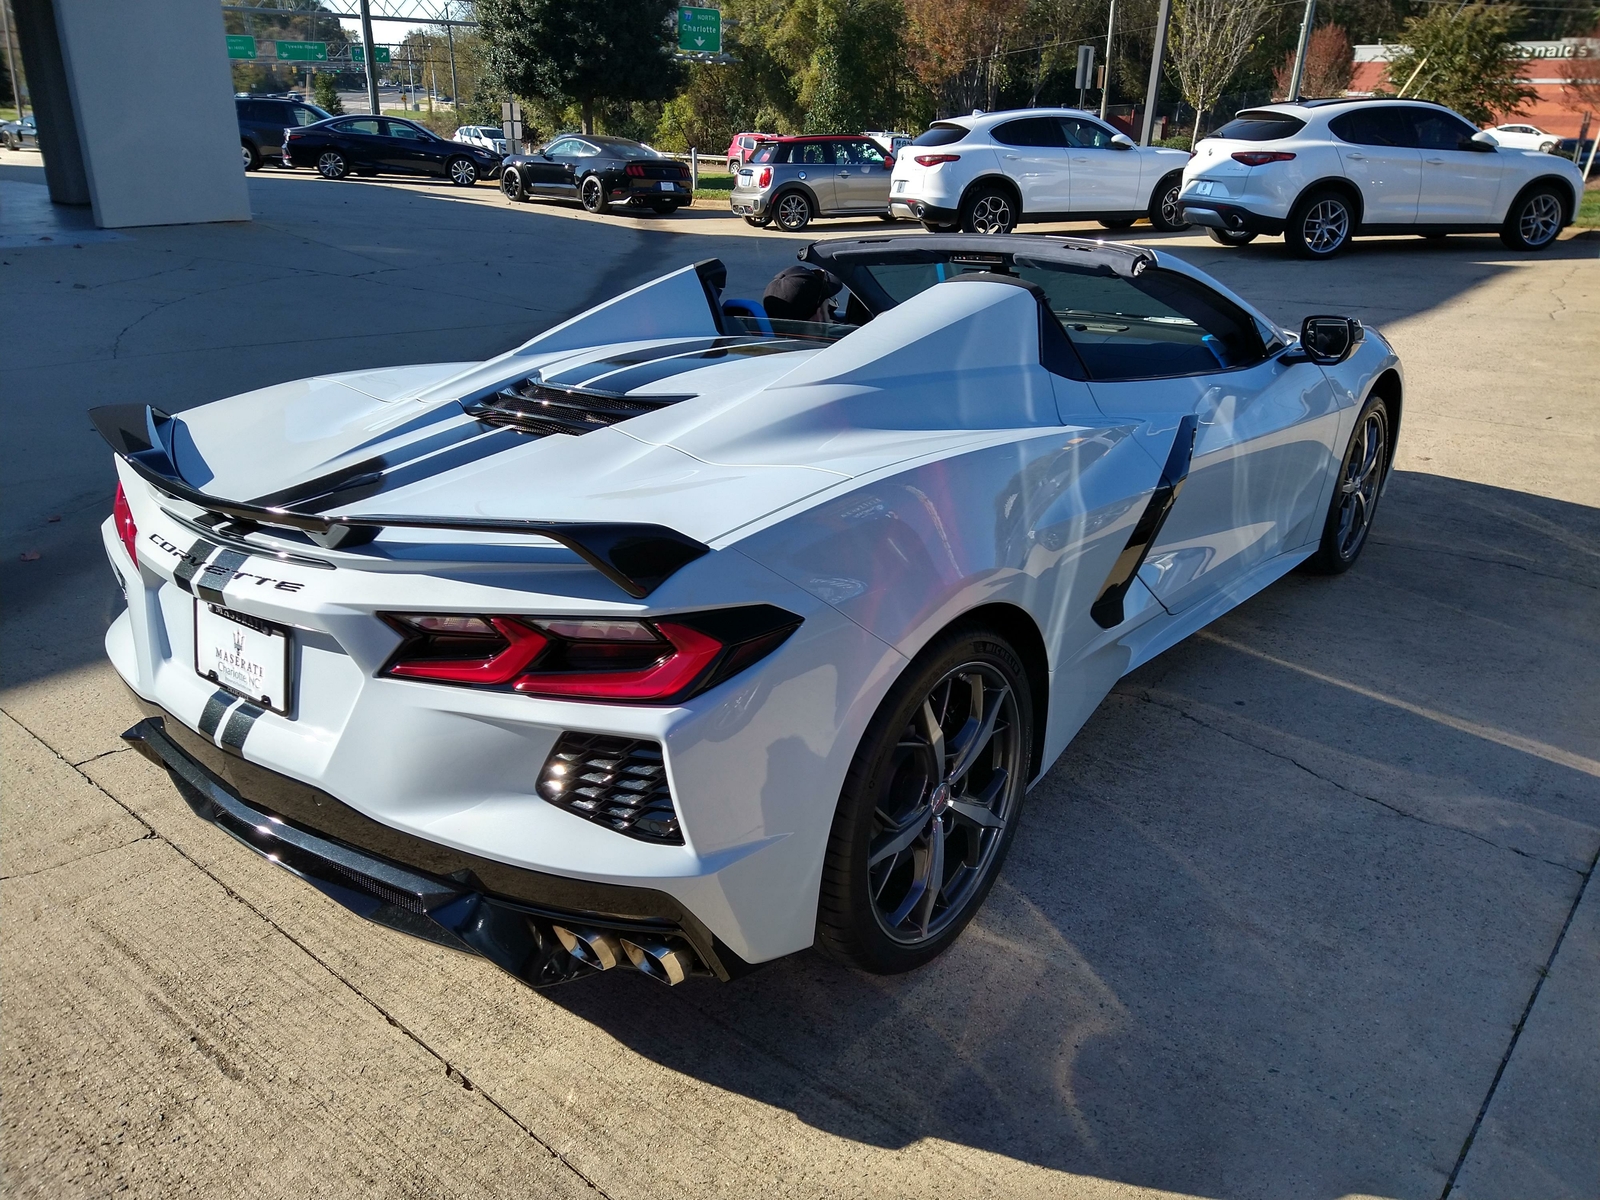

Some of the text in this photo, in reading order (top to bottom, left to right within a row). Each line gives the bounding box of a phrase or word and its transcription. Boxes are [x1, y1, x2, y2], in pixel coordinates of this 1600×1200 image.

[682, 24, 716, 33] Charlotte
[148, 533, 305, 593] CORVETTE
[215, 646, 264, 678] MASERATI
[985, 642, 1020, 674] MICHELIN
[248, 672, 261, 690] NC
